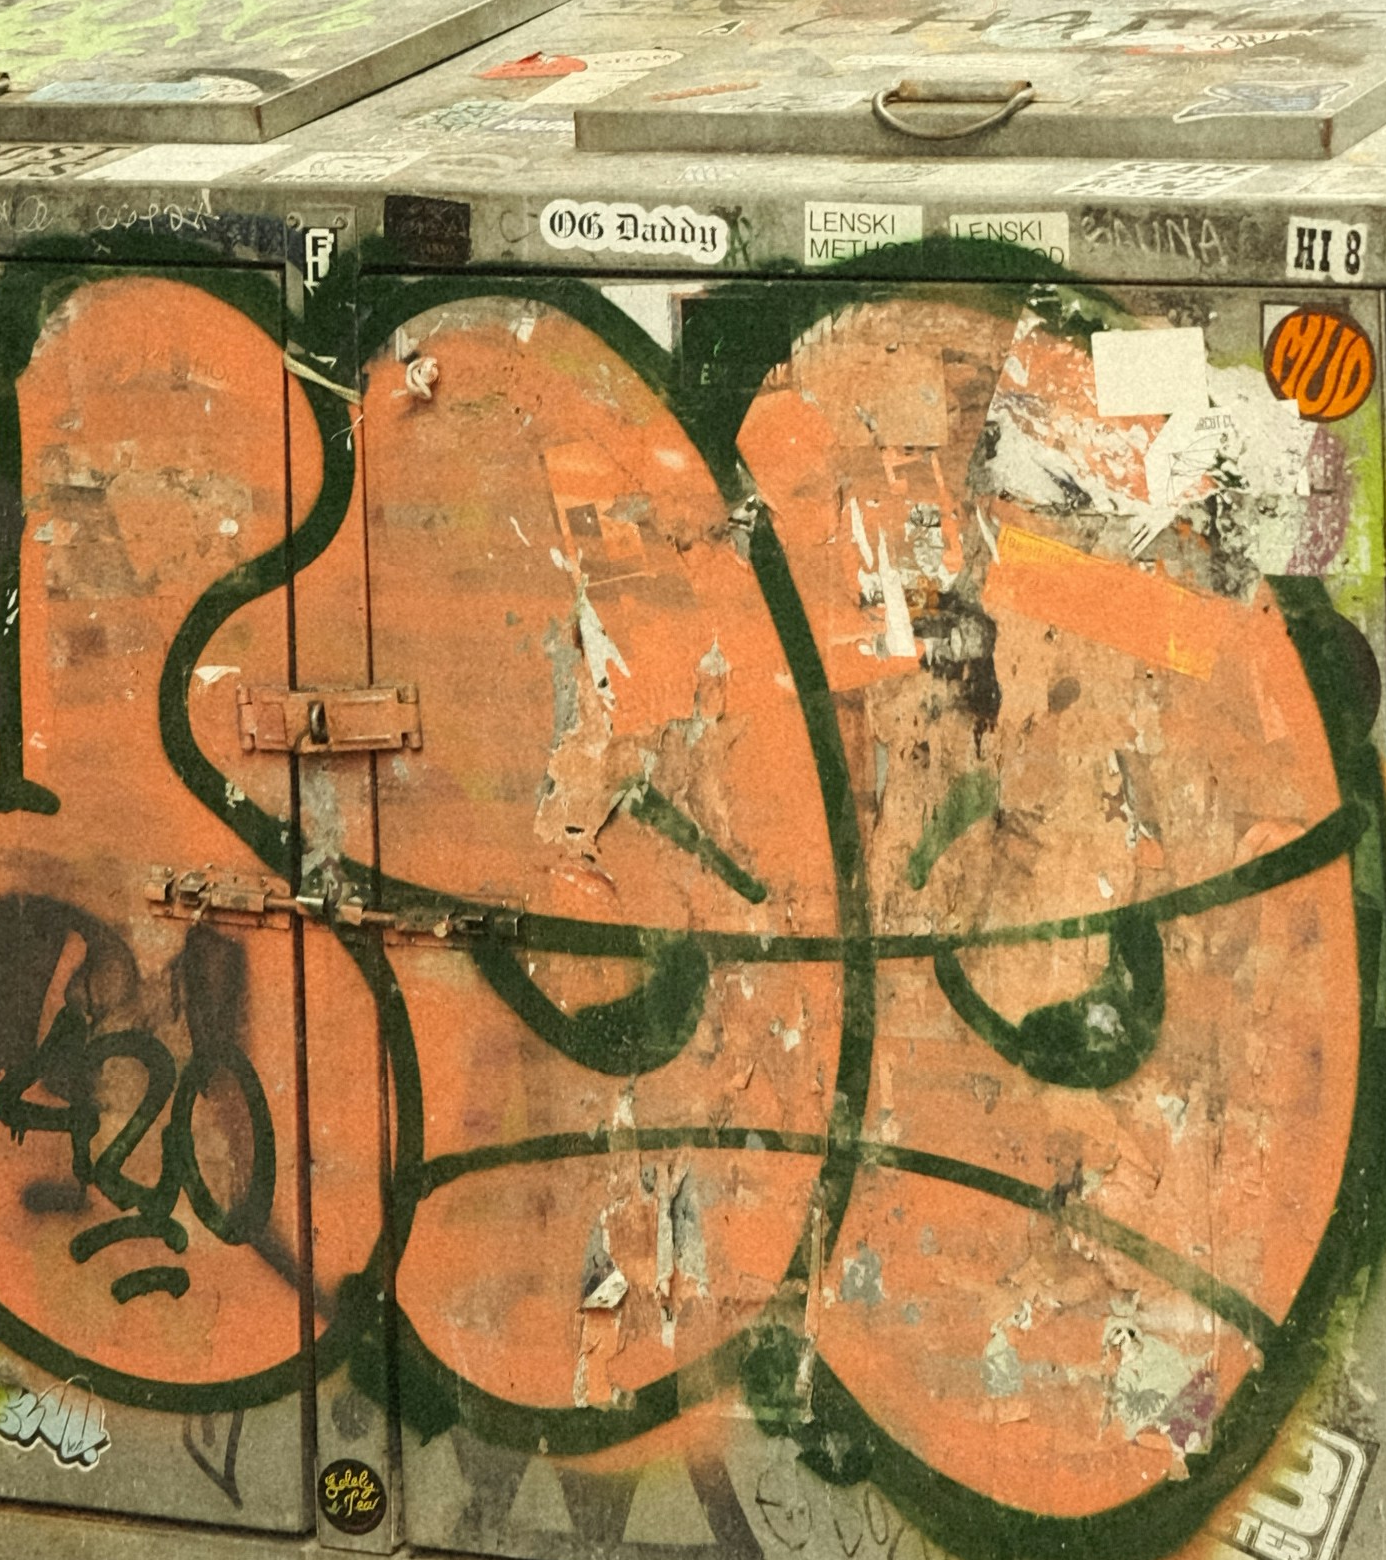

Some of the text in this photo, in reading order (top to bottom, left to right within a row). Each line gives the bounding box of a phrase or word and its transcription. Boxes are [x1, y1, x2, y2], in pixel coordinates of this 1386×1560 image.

[548, 208, 719, 253] OG Daddy
[809, 209, 896, 236] LENSKI
[954, 220, 1043, 243] LENSKI
[809, 237, 918, 261] METHO
[1294, 225, 1363, 276] HI 8
[1269, 308, 1373, 421] MUD
